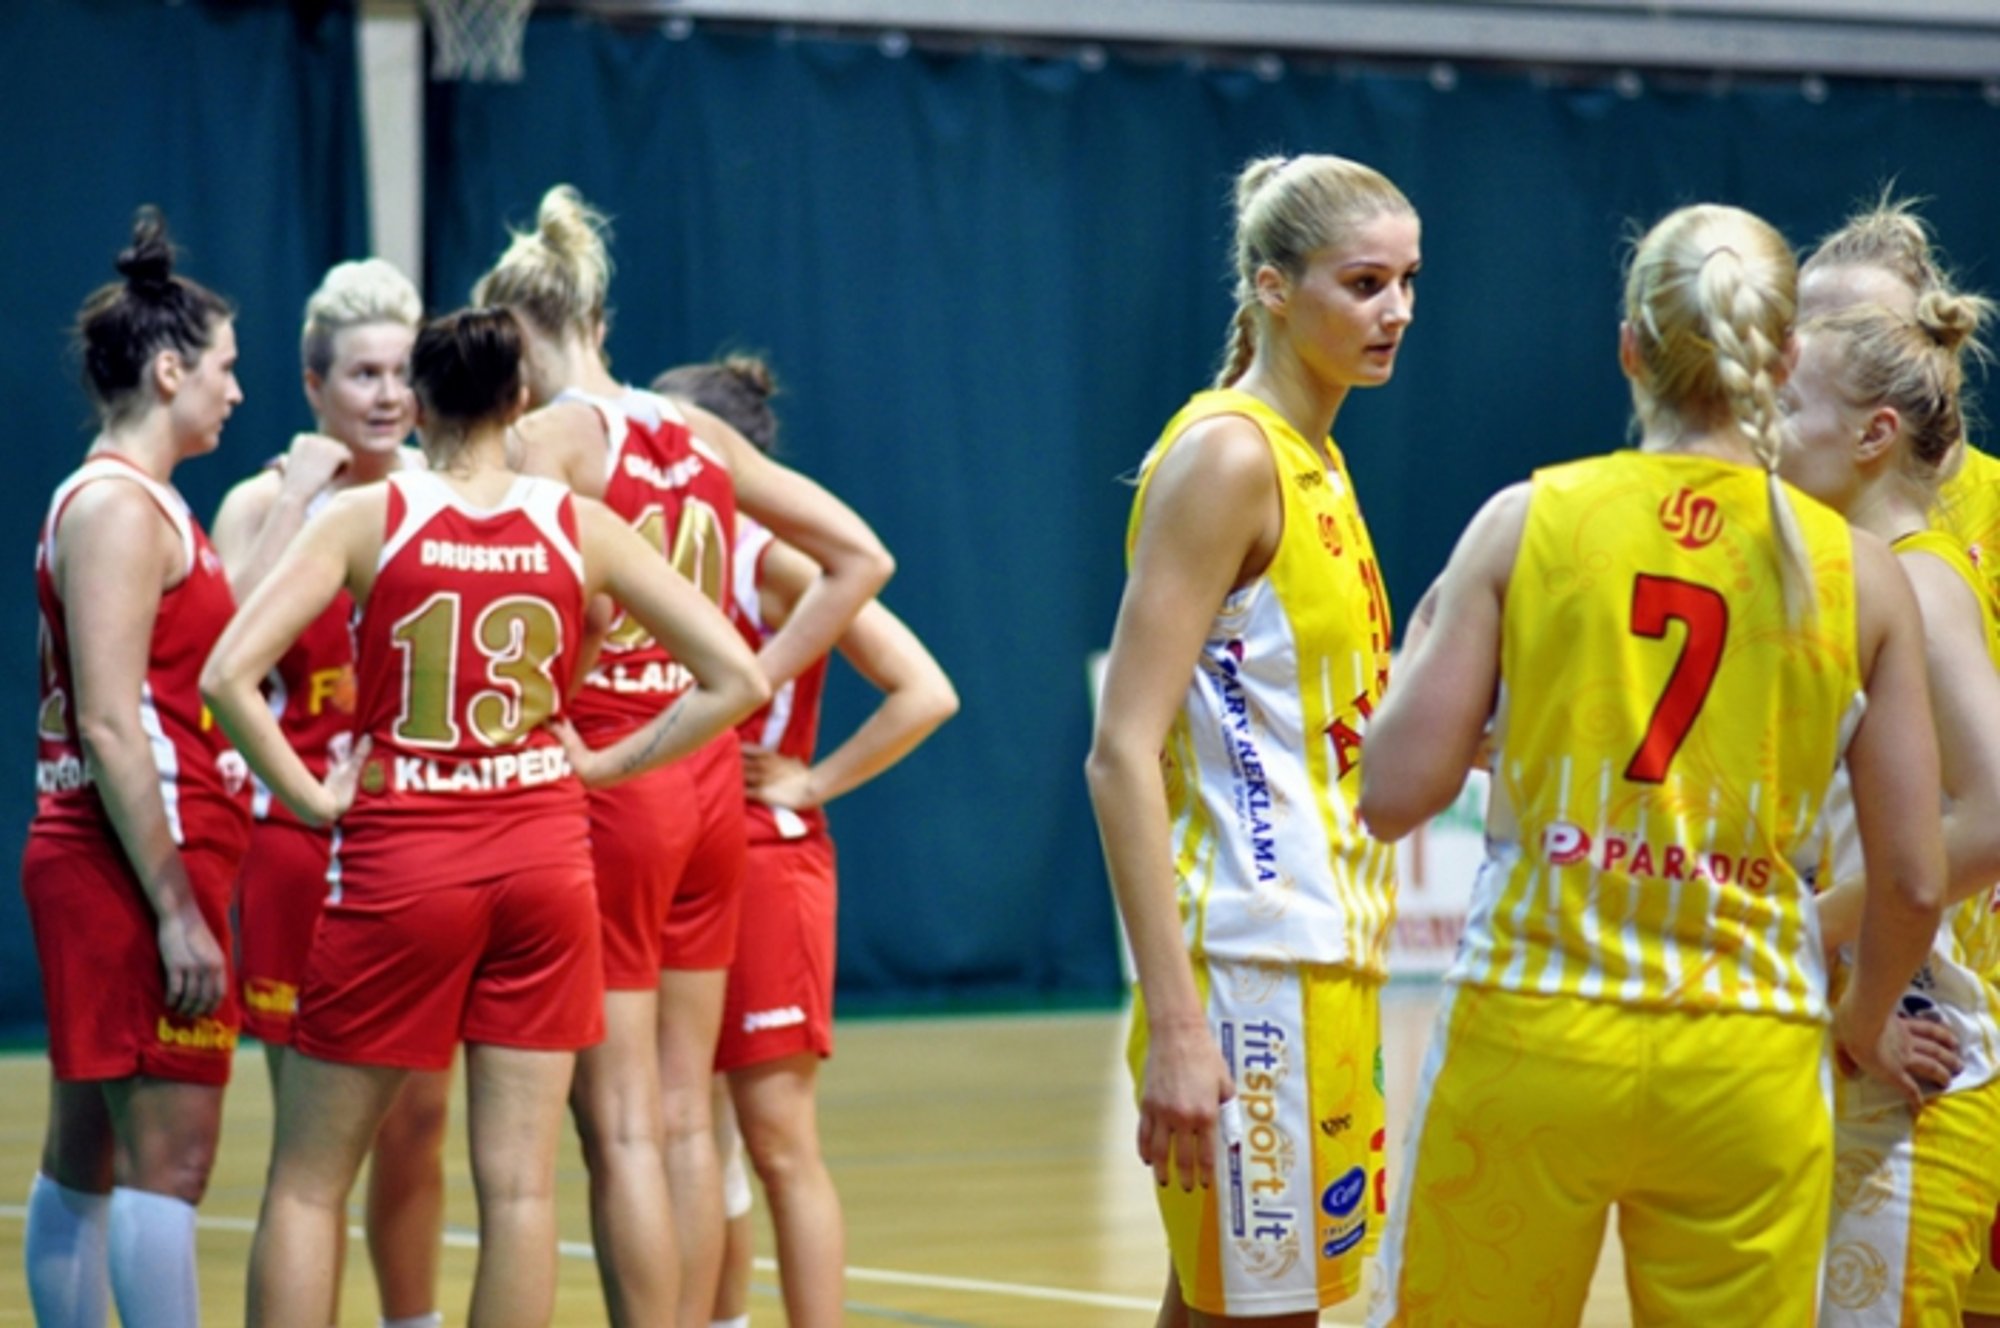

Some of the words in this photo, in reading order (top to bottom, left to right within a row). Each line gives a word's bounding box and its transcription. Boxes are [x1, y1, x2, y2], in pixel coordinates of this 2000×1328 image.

[391, 591, 563, 749] 13
[1625, 573, 1728, 785] 7
[1238, 740, 1277, 882] REKLAMA
[1239, 1021, 1294, 1241] fitsport.lt
